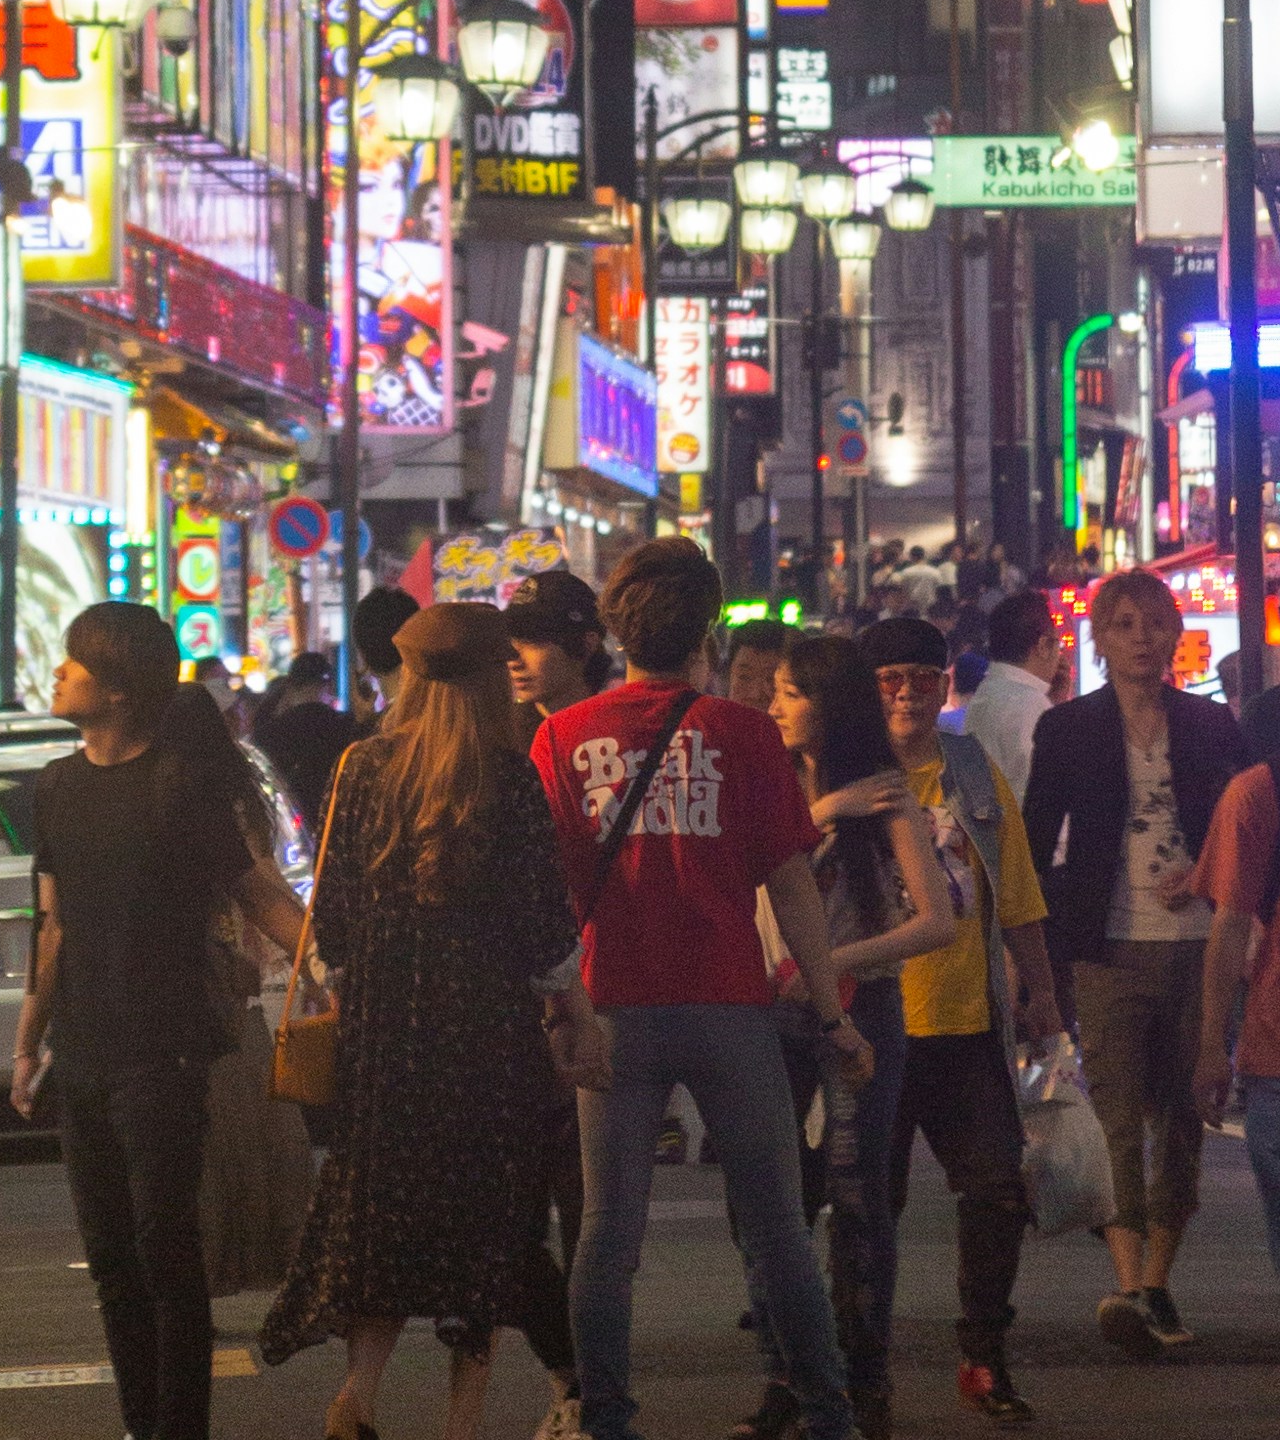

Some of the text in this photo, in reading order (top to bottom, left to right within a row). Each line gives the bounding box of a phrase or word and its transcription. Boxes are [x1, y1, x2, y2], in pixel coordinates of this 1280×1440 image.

[982, 179, 1095, 199] Kabukicho
[679, 296, 703, 417] カラオケ
[572, 728, 724, 790] Brak
